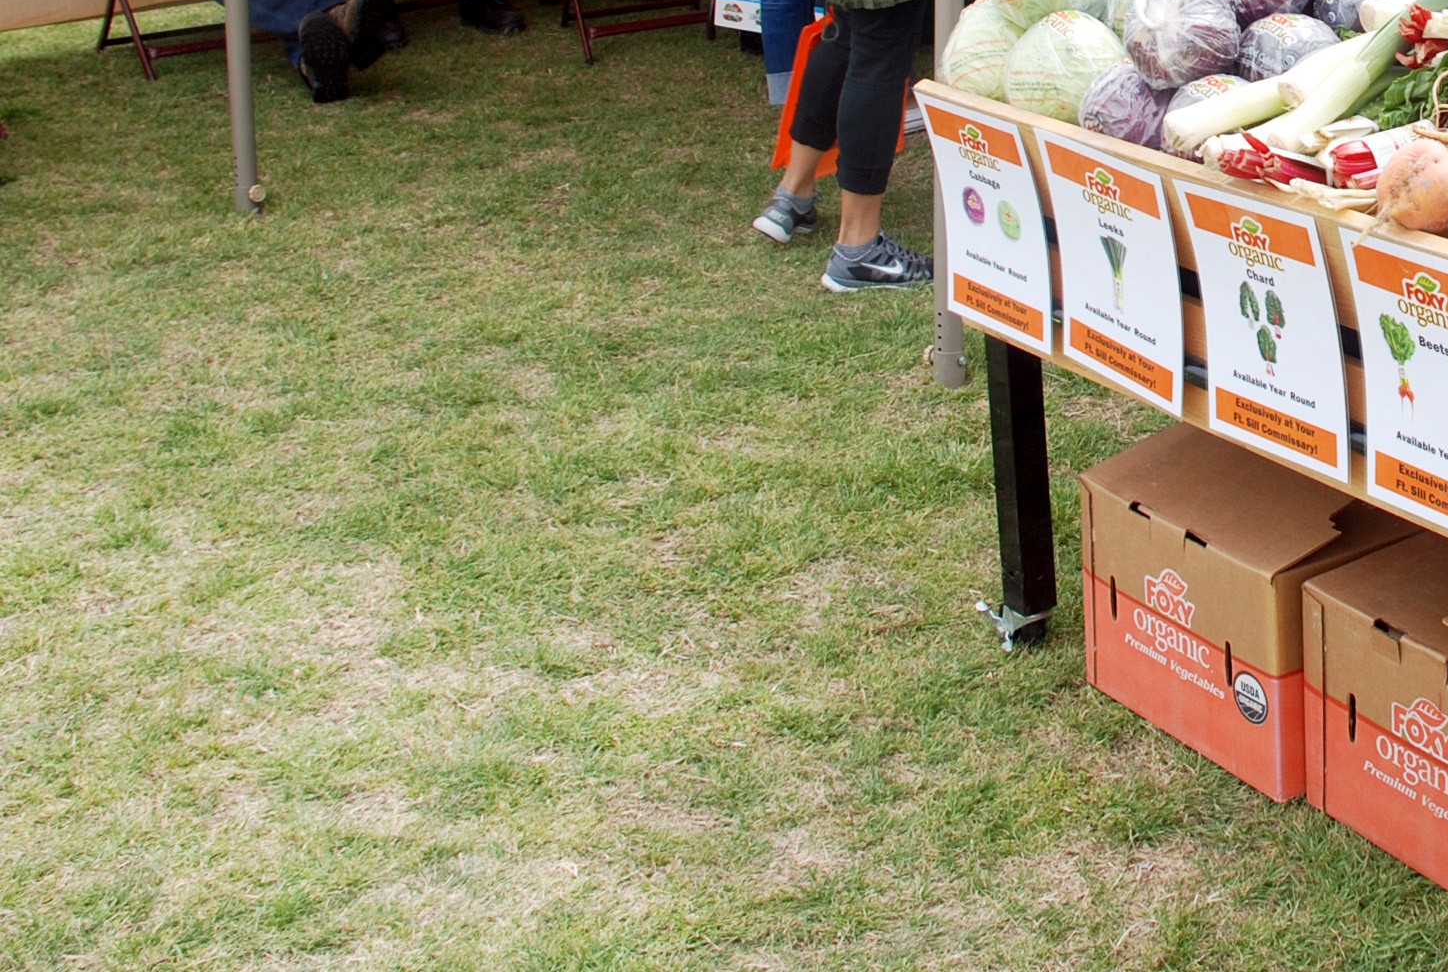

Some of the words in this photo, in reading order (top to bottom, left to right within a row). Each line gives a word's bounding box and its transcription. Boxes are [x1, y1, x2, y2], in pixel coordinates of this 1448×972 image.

[959, 147, 1000, 171] organic
[961, 132, 987, 154] FOXY
[969, 170, 1000, 190] Cabbage
[1088, 175, 1118, 200] FOXY
[1082, 189, 1132, 221] organic
[1098, 217, 1124, 237] Leeks
[1233, 226, 1267, 250] FOXY
[966, 248, 991, 266] Available
[993, 261, 1005, 272] Year
[1008, 267, 1027, 282] Round
[1228, 241, 1284, 272] organic
[1246, 268, 1275, 287] Chard
[967, 281, 1002, 305] Exclusively
[1004, 299, 1011, 308] at
[1012, 301, 1027, 315] Your
[1405, 282, 1445, 310] FOXY
[976, 298, 986, 310] Sill
[987, 304, 1029, 331] Commissary!
[1085, 302, 1114, 323] Available
[1116, 318, 1130, 331] Year
[1134, 328, 1156, 345] Round
[1087, 329, 1127, 358] Exclusively
[1128, 352, 1136, 363] at
[1138, 355, 1154, 372] Your
[1096, 347, 1107, 360] Sill
[1108, 355, 1156, 388] Commissary!
[1233, 369, 1267, 390] Available
[1269, 383, 1286, 396] Year
[1290, 391, 1316, 409] Round
[1233, 412, 1243, 424] Ft.
[1246, 417, 1259, 430] Sill
[1261, 424, 1318, 454] Commissary!
[1235, 397, 1282, 426] Exclusively
[1284, 419, 1293, 429] at
[1295, 422, 1315, 437] Your
[1396, 430, 1436, 455] Available
[1396, 479, 1408, 492] Ft.
[1410, 485, 1426, 500] Sill
[1144, 575, 1195, 628] FOXY
[1133, 608, 1210, 669] organic
[1124, 632, 1167, 666] Premium
[1170, 659, 1225, 699] Vegetables
[1240, 680, 1260, 700] USDA
[1363, 760, 1417, 800] Premium
